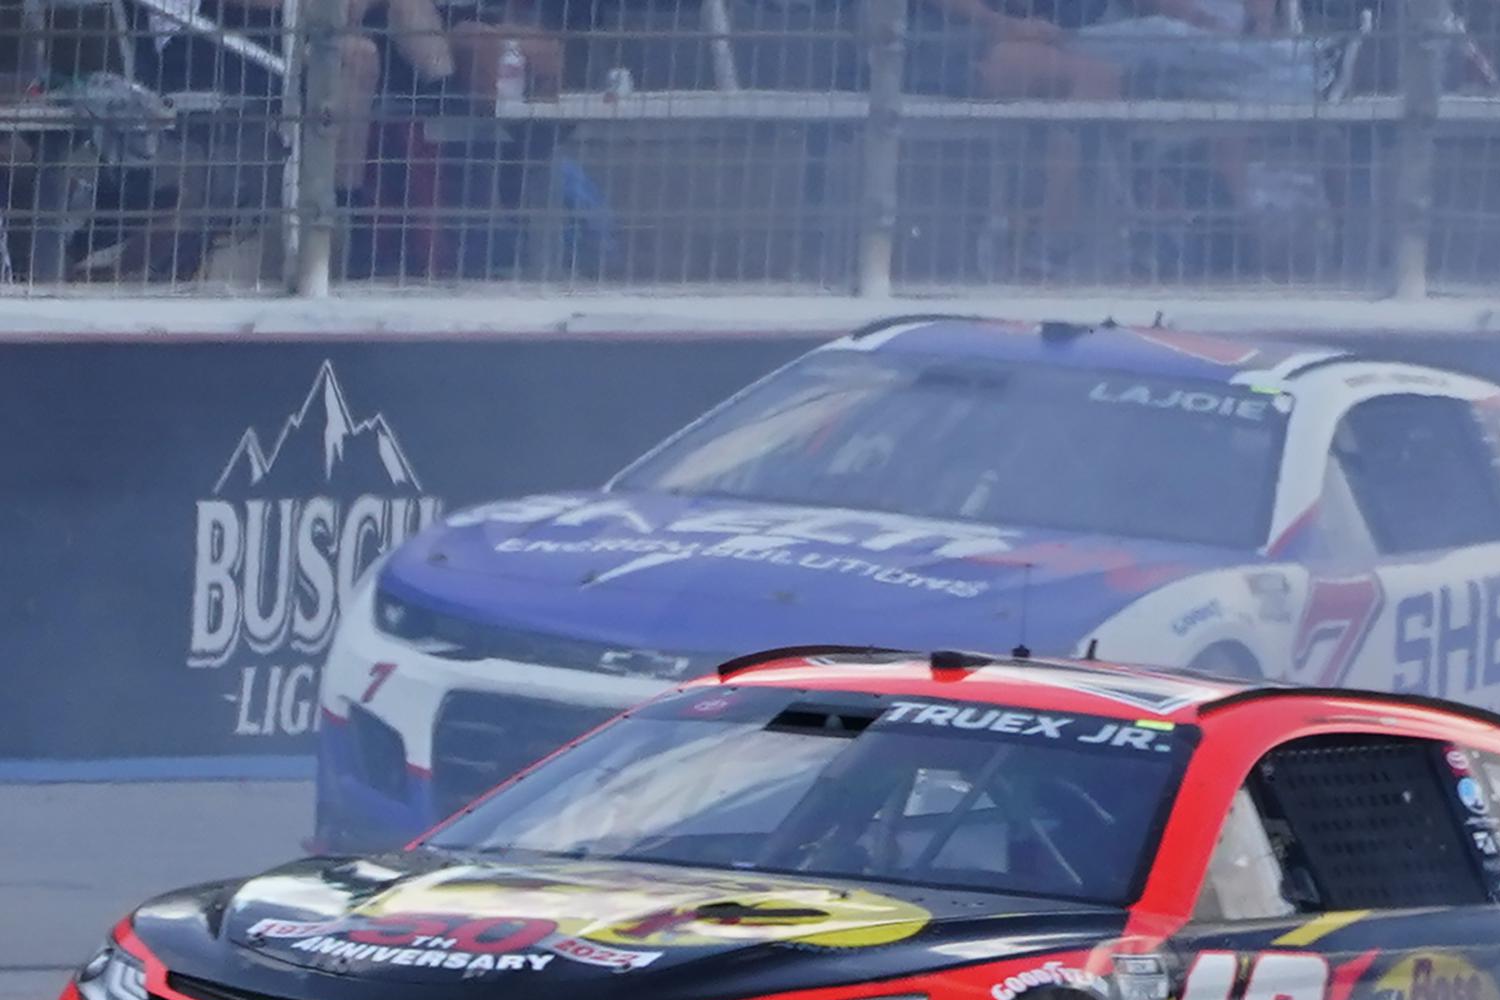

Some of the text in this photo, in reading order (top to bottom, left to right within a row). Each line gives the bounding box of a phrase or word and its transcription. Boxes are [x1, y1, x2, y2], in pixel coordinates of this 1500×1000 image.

[1089, 382, 1270, 421] LAJOIE
[361, 662, 398, 703] 7
[885, 701, 1171, 752] TRUEX JR.
[291, 935, 556, 971] ANNIVERSARY
[411, 936, 458, 949] TH
